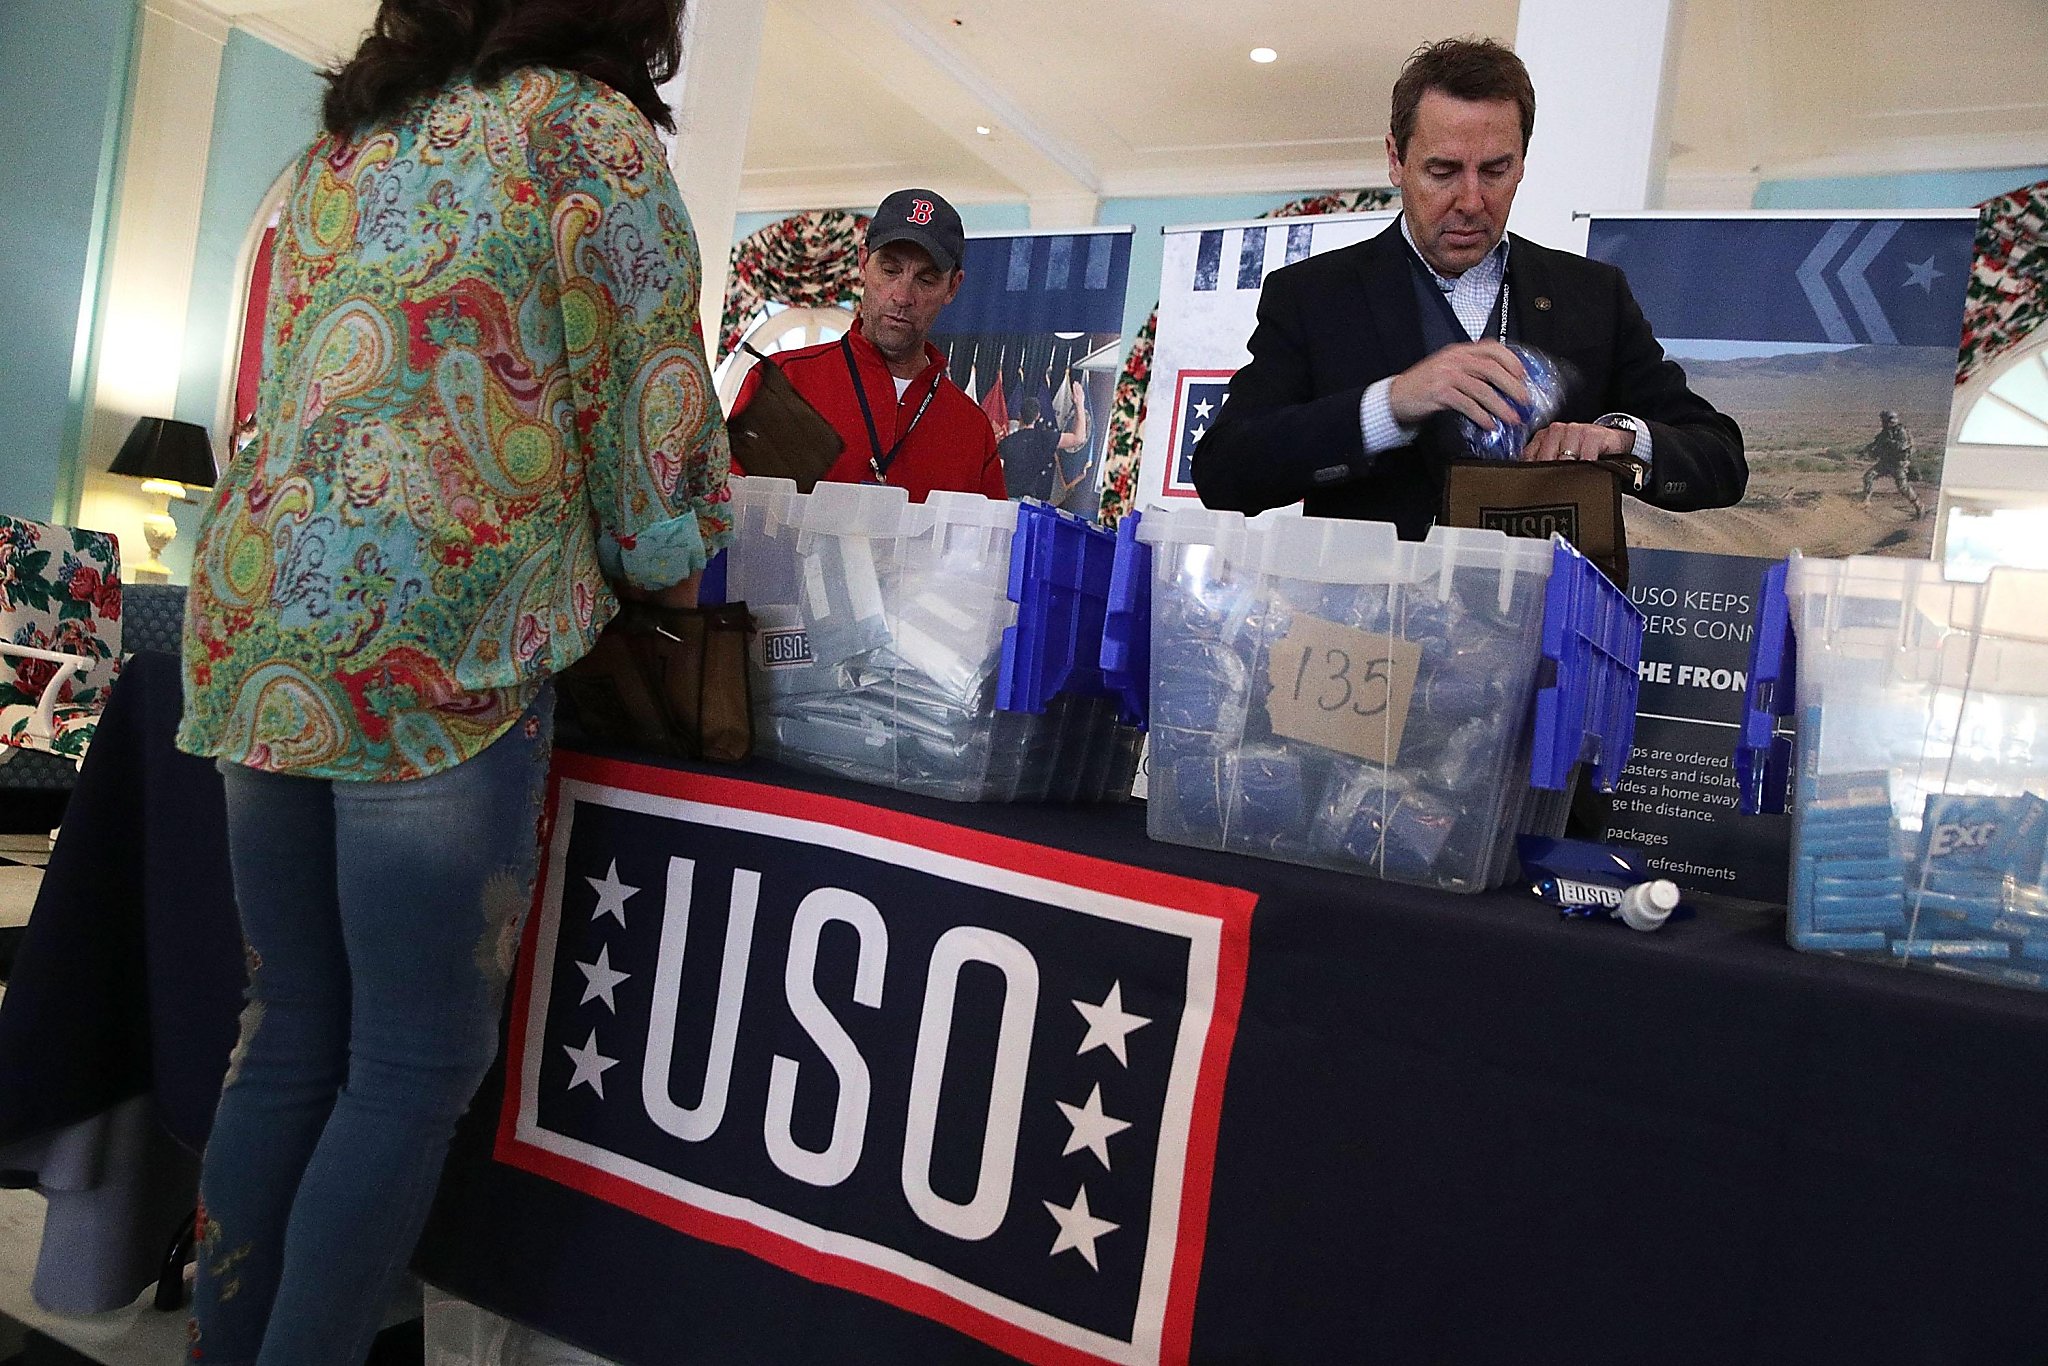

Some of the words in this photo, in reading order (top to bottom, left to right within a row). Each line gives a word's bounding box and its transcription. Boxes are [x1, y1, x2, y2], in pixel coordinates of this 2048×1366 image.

[907, 199, 935, 225] B
[1631, 586, 1678, 607] USO
[1684, 590, 1750, 614] KEEPS
[773, 635, 803, 660] USO
[1293, 646, 1396, 716] 135
[1638, 661, 1672, 684] HE
[1677, 665, 1748, 692] FRON
[1650, 750, 1672, 761] are
[1675, 751, 1728, 768] ordered
[1671, 769, 1697, 783] and
[1650, 786, 1658, 796] a
[1661, 785, 1700, 801] home
[1702, 793, 1739, 809] away
[1612, 799, 1628, 811] ge
[1631, 799, 1653, 813] the
[1655, 803, 1715, 822] distance.
[1607, 828, 1669, 846] packages
[1646, 857, 1737, 881] refreshments
[642, 855, 1040, 1242] USO
